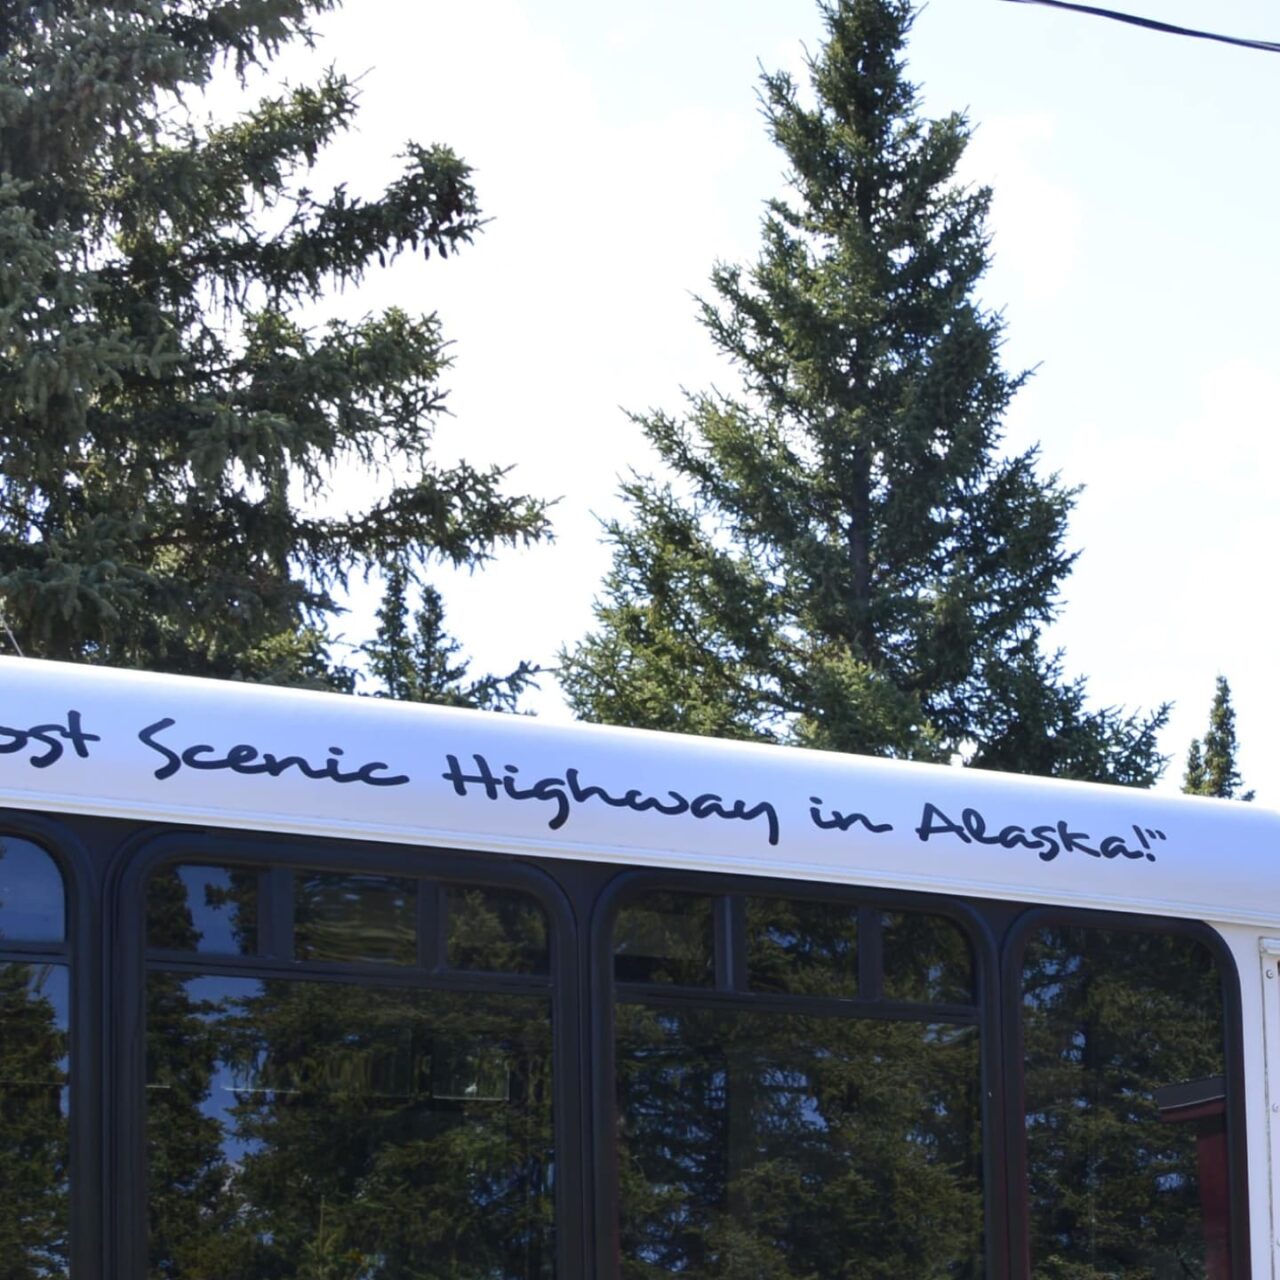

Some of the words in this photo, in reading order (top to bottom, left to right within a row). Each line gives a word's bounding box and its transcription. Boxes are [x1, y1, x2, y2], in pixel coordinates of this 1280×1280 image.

[138, 717, 410, 787] Scenic
[442, 754, 780, 846] Highway
[809, 796, 894, 834] in
